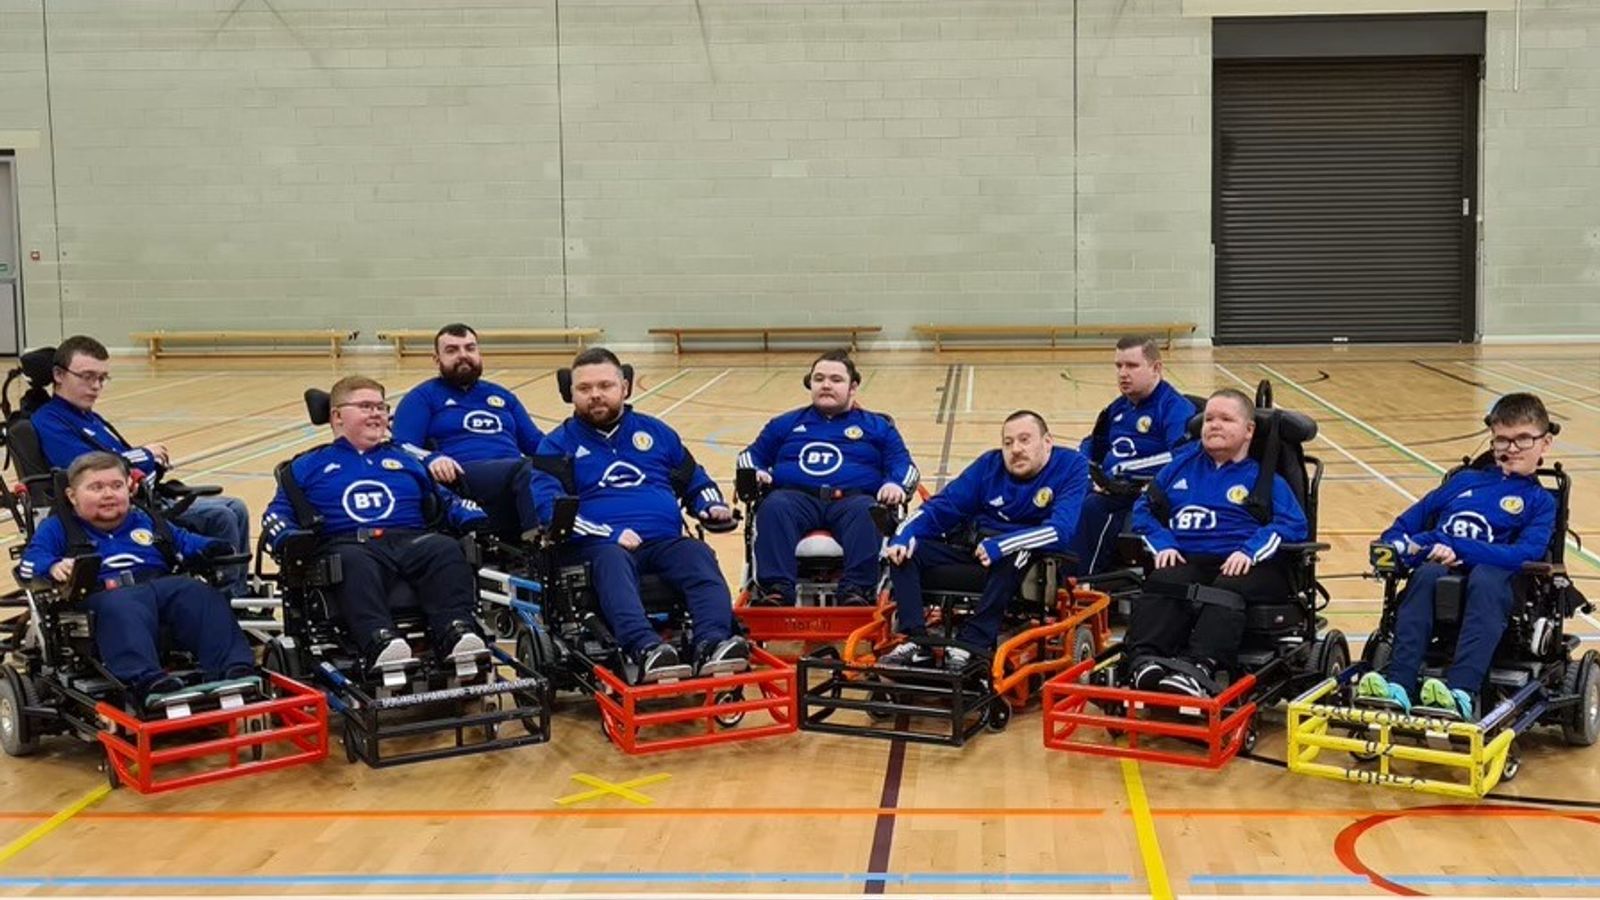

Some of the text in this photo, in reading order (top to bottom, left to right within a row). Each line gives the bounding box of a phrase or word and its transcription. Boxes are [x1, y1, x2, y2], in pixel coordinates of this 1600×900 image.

[808, 452, 834, 464] BT
[354, 492, 384, 509] BT
[1178, 512, 1206, 529] BT
[1453, 520, 1483, 540] BT
[1374, 547, 1395, 566] 2
